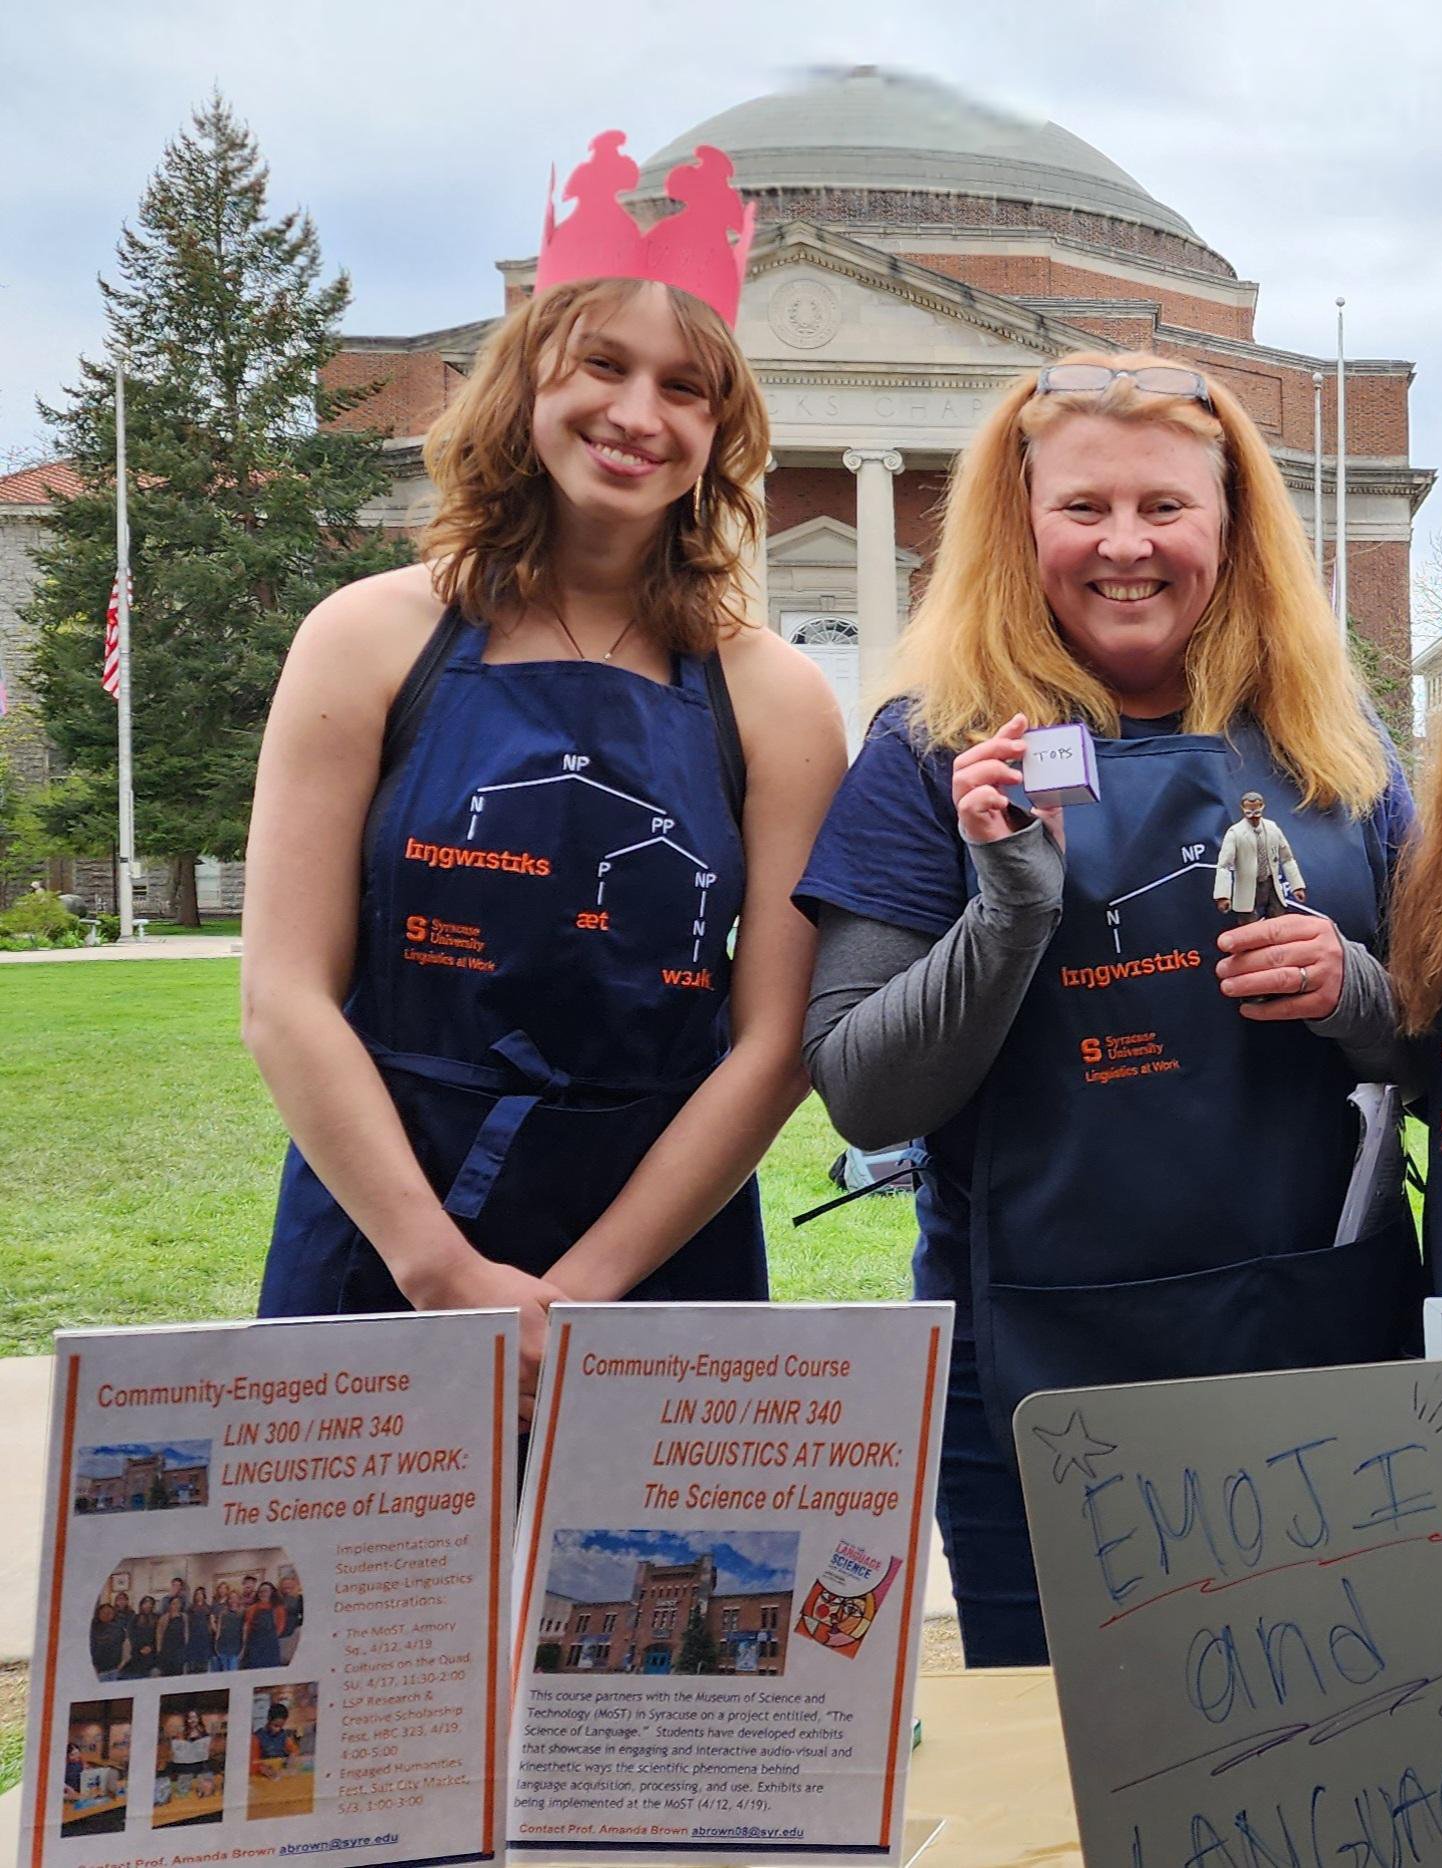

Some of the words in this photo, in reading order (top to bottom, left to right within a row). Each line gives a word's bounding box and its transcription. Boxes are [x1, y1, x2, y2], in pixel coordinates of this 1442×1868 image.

[563, 754, 591, 771] NP
[1033, 747, 1073, 762] TOPS
[470, 796, 484, 812] N
[651, 817, 675, 834] PP
[1181, 843, 1206, 864] NP
[597, 861, 611, 878] P
[694, 872, 717, 889] NP
[1106, 910, 1120, 925] N
[406, 915, 428, 941] S
[692, 919, 706, 937] N
[430, 932, 486, 951] University
[1081, 1038, 1102, 1063] S
[1108, 1043, 1164, 1060] University
[1152, 1060, 1180, 1073] Work
[582, 1353, 779, 1382] Community-Engaged
[784, 1355, 850, 1377] Course
[98, 1373, 327, 1409] Community-Engaged
[336, 1370, 410, 1394] Course
[660, 1400, 697, 1424] LIN
[702, 1400, 735, 1424] 300
[754, 1400, 799, 1424] HNR
[807, 1400, 842, 1424] 340
[224, 1423, 257, 1447] LIN
[264, 1420, 300, 1444] 300
[317, 1417, 363, 1441] HNR
[369, 1415, 403, 1438] 340
[653, 1441, 788, 1467] LINGUISTICS
[793, 1441, 824, 1467] AT
[829, 1442, 902, 1467] WORK:
[222, 1456, 358, 1486] LINGUISTICS
[362, 1453, 395, 1477] AT
[399, 1448, 469, 1474] WORK:
[224, 1502, 258, 1526] The
[267, 1497, 345, 1522] Science
[352, 1494, 374, 1517] of
[378, 1489, 476, 1517] Language
[643, 1484, 682, 1509] The
[687, 1484, 767, 1510] Science
[772, 1484, 795, 1509] of
[799, 1486, 899, 1516] Language
[1083, 1436, 1437, 1605] EMOJI
[830, 1553, 873, 1579] SCIENCE
[1186, 1578, 1386, 1723] and
[530, 1689, 553, 1701] This
[555, 1691, 593, 1702] course
[595, 1691, 642, 1704] partners
[646, 1690, 671, 1702] with
[674, 1691, 692, 1702] the
[695, 1692, 741, 1703] Museum
[743, 1692, 756, 1703] of
[758, 1692, 801, 1704] Science
[804, 1693, 825, 1704] and
[527, 1707, 591, 1720] Technology
[594, 1708, 632, 1720] (MoST)
[635, 1709, 646, 1719] in
[648, 1709, 698, 1721] Syracuse
[700, 1711, 714, 1721] on
[717, 1711, 725, 1721] a
[728, 1710, 770, 1723] project
[524, 1725, 567, 1737] Science
[570, 1725, 583, 1737] of
[656, 1726, 704, 1738] Students
[707, 1727, 734, 1738] have
[738, 1727, 796, 1740] developed
[799, 1728, 844, 1740] exhibits
[522, 1743, 545, 1754] that
[548, 1744, 601, 1755] showcase
[605, 1745, 615, 1755] in
[619, 1745, 669, 1758] engaging
[671, 1744, 693, 1755] and
[760, 1745, 828, 1757] audio-visual
[831, 1746, 853, 1758] and
[519, 1761, 581, 1773] kinesthetic
[585, 1764, 612, 1775] ways
[616, 1762, 635, 1773] the
[637, 1762, 689, 1773] scientific
[692, 1763, 757, 1776] phenomena
[761, 1764, 800, 1775] behind
[516, 1780, 567, 1792] language
[706, 1782, 728, 1792] and
[757, 1782, 802, 1793] Exhibits
[804, 1784, 824, 1794] are
[514, 1797, 546, 1810] being
[548, 1798, 624, 1811] implemented
[627, 1799, 639, 1809] at
[642, 1799, 661, 1809] the
[664, 1798, 694, 1809] MoST
[519, 1824, 565, 1834] Contact
[567, 1825, 595, 1835] Prof.
[598, 1825, 647, 1835] Amanda
[650, 1825, 688, 1835] Brown
[171, 1851, 228, 1866] Amanda
